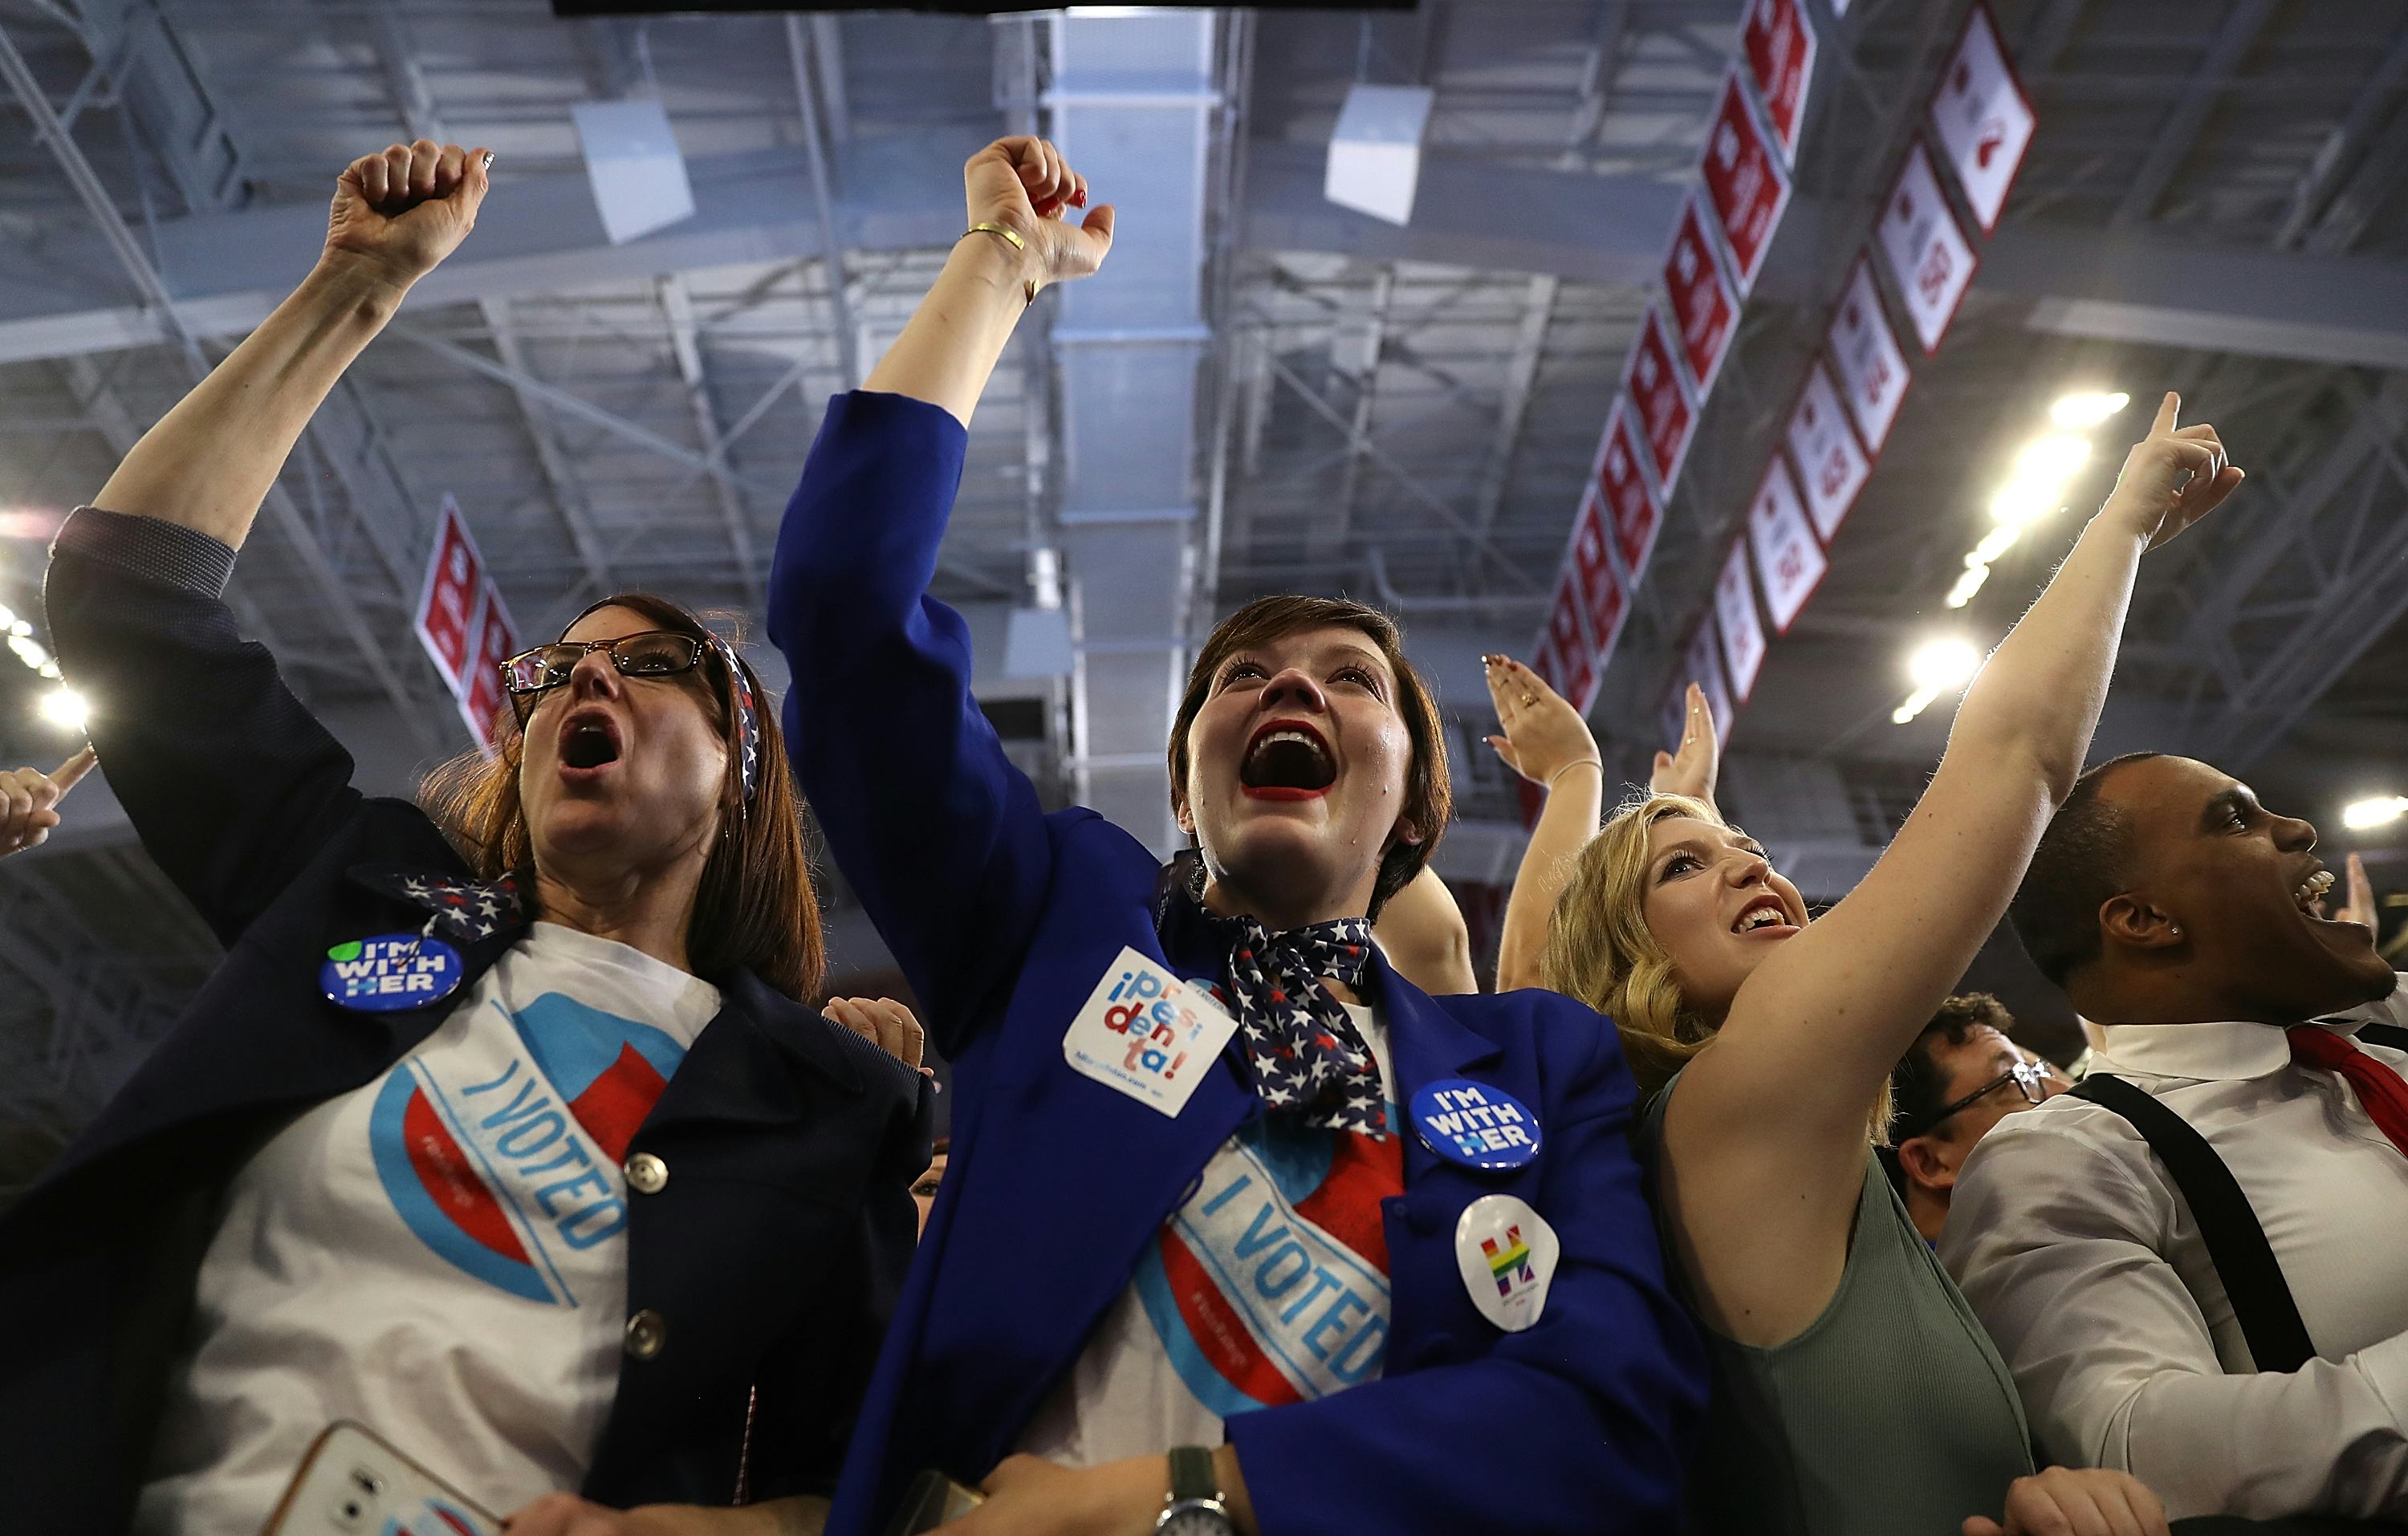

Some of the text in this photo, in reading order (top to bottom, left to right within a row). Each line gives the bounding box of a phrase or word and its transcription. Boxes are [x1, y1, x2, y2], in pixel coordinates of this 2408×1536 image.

[364, 941, 421, 960] I'M
[334, 955, 445, 979] WITH
[345, 973, 434, 998] HER
[1433, 1087, 1488, 1112] I'M
[1426, 1103, 1524, 1136] WITH
[1453, 1124, 1532, 1156] HER
[482, 1079, 628, 1251] VOTED
[1202, 1173, 1252, 1217] I
[1234, 1202, 1389, 1384] VOTED
